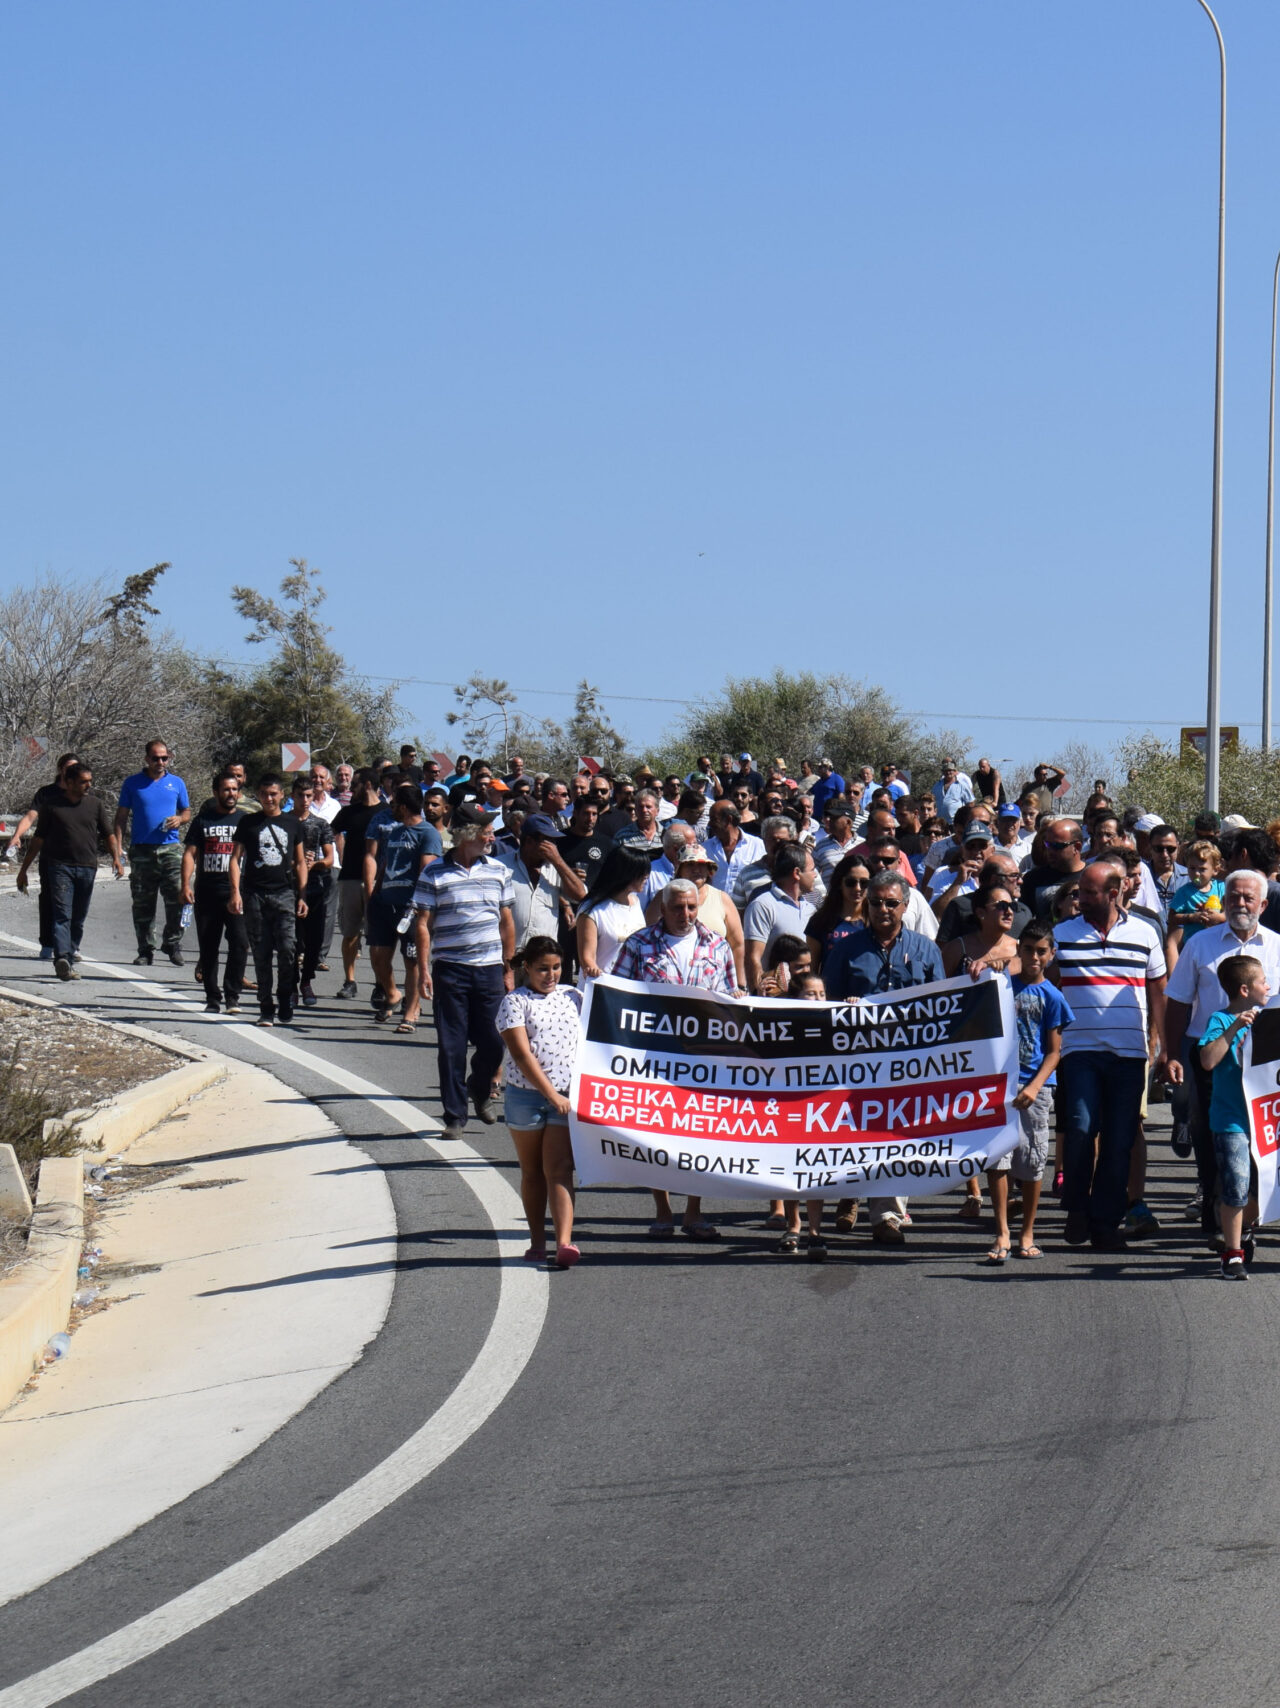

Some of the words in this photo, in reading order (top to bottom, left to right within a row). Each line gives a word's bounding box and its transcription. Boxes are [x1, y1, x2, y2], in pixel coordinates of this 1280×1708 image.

[203, 825, 237, 837] LEGEN
[203, 854, 231, 872] DECEM
[619, 1008, 699, 1037] ΠΕΔΙΟ
[707, 1018, 794, 1043] ΒΟΛΗΣ
[804, 1028, 821, 1038] =
[831, 993, 964, 1027] ΚΙΝΔΥΝΟΣ
[832, 1020, 951, 1051] ΘΑΝΑΤΟΣ
[610, 1055, 718, 1084] ΟΜΗΡΟΙ
[726, 1065, 776, 1087] ΤΟΥ
[785, 1061, 882, 1087] ΠΕΔΙΟΥ
[890, 1050, 975, 1082] ΒΟΛΗΣ
[590, 1082, 676, 1109] ΤΟΞΙΚΑ
[683, 1093, 756, 1115] ΑΕΡΙΑ
[764, 1098, 780, 1116] &
[787, 1113, 802, 1122] =
[805, 1086, 998, 1133] ΚΑΡΚΙΝΟΣ
[589, 1101, 665, 1128] ΒΑΡΕΑ
[671, 1113, 779, 1137] ΜΕΤΑΛΛΑ
[601, 1138, 669, 1167] ΠΕΔΙΟ
[677, 1151, 760, 1175] ΒΟΛΗΣ
[770, 1166, 785, 1175] =
[795, 1138, 953, 1167] ΚΑΤΑΣΤΡΟΦΗ
[793, 1170, 837, 1189] ΤΗΣ
[846, 1156, 988, 1184] ΞΥΛΟΦΑΓΟΥ
